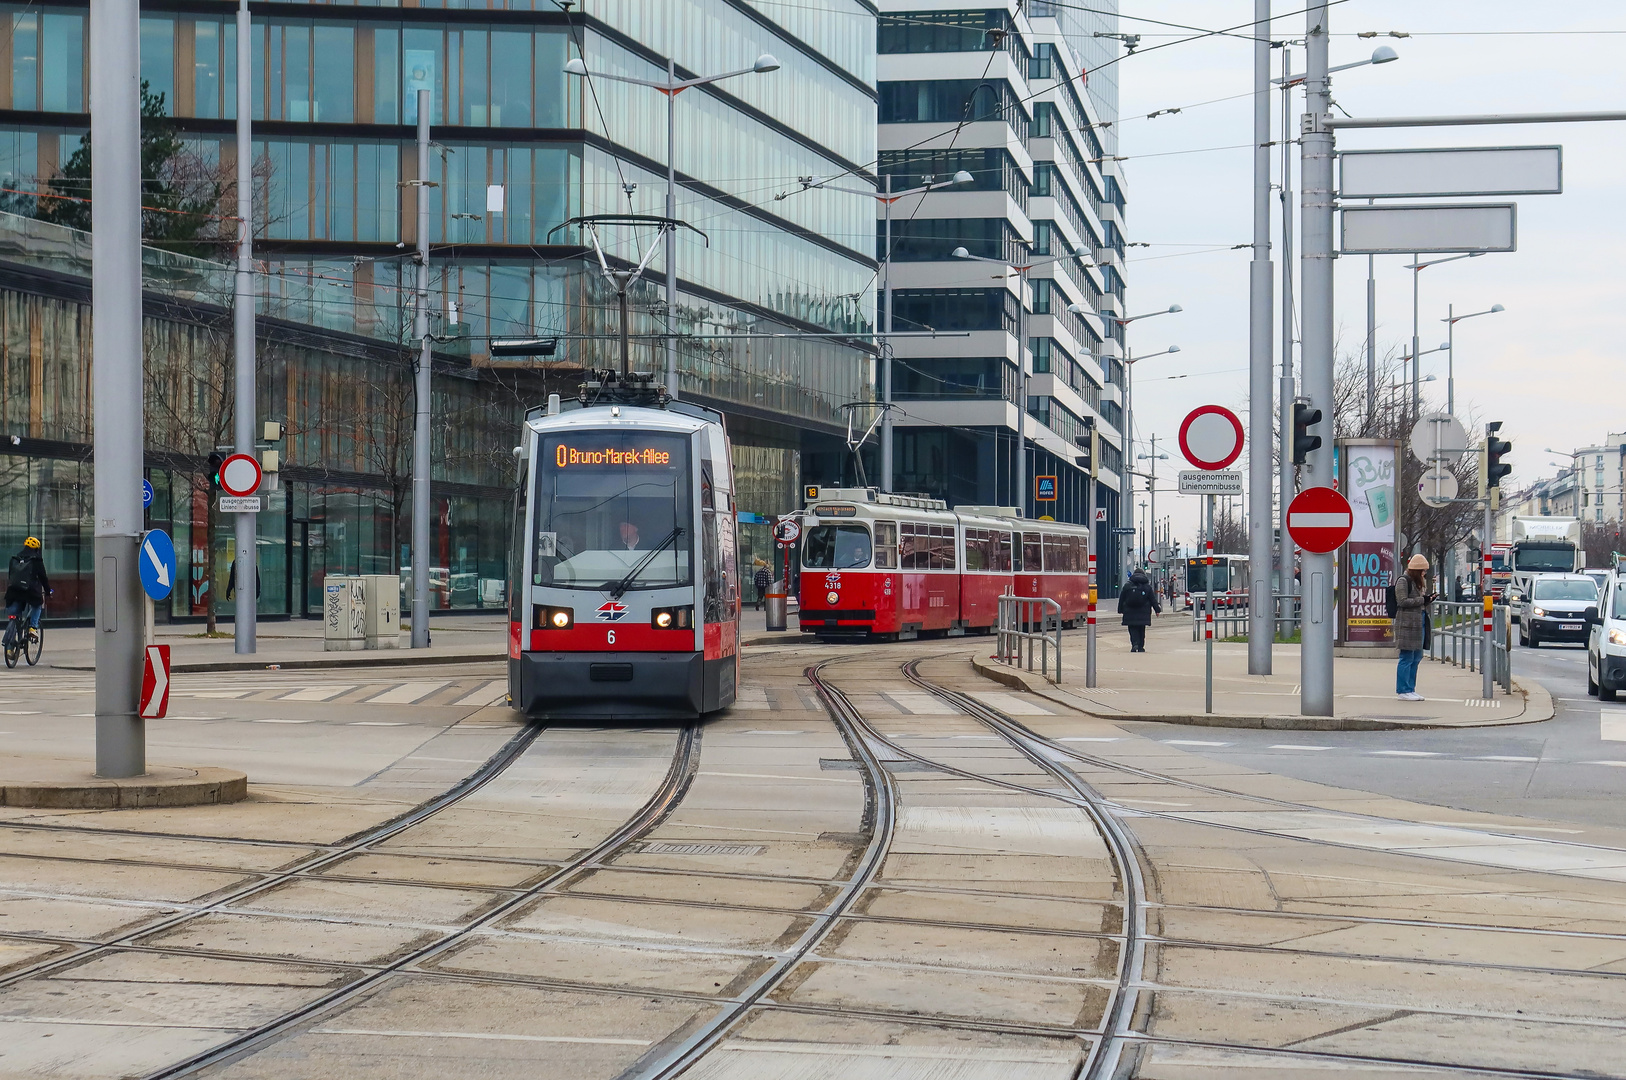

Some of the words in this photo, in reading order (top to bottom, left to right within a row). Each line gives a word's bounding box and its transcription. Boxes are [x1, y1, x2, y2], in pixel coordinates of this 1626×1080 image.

[569, 448, 670, 464] Bruno-Marek-Allee
[1182, 474, 1240, 482] ausgenommen
[808, 488, 817, 497] 18
[1095, 510, 1106, 519] A1
[1350, 553, 1381, 574] WO
[1350, 576, 1380, 587] SIND
[1380, 570, 1388, 587] DIE
[824, 582, 842, 590] 4318
[1350, 588, 1386, 604] PLAU
[1350, 605, 1388, 616] TASCHE
[606, 629, 616, 645] 6
